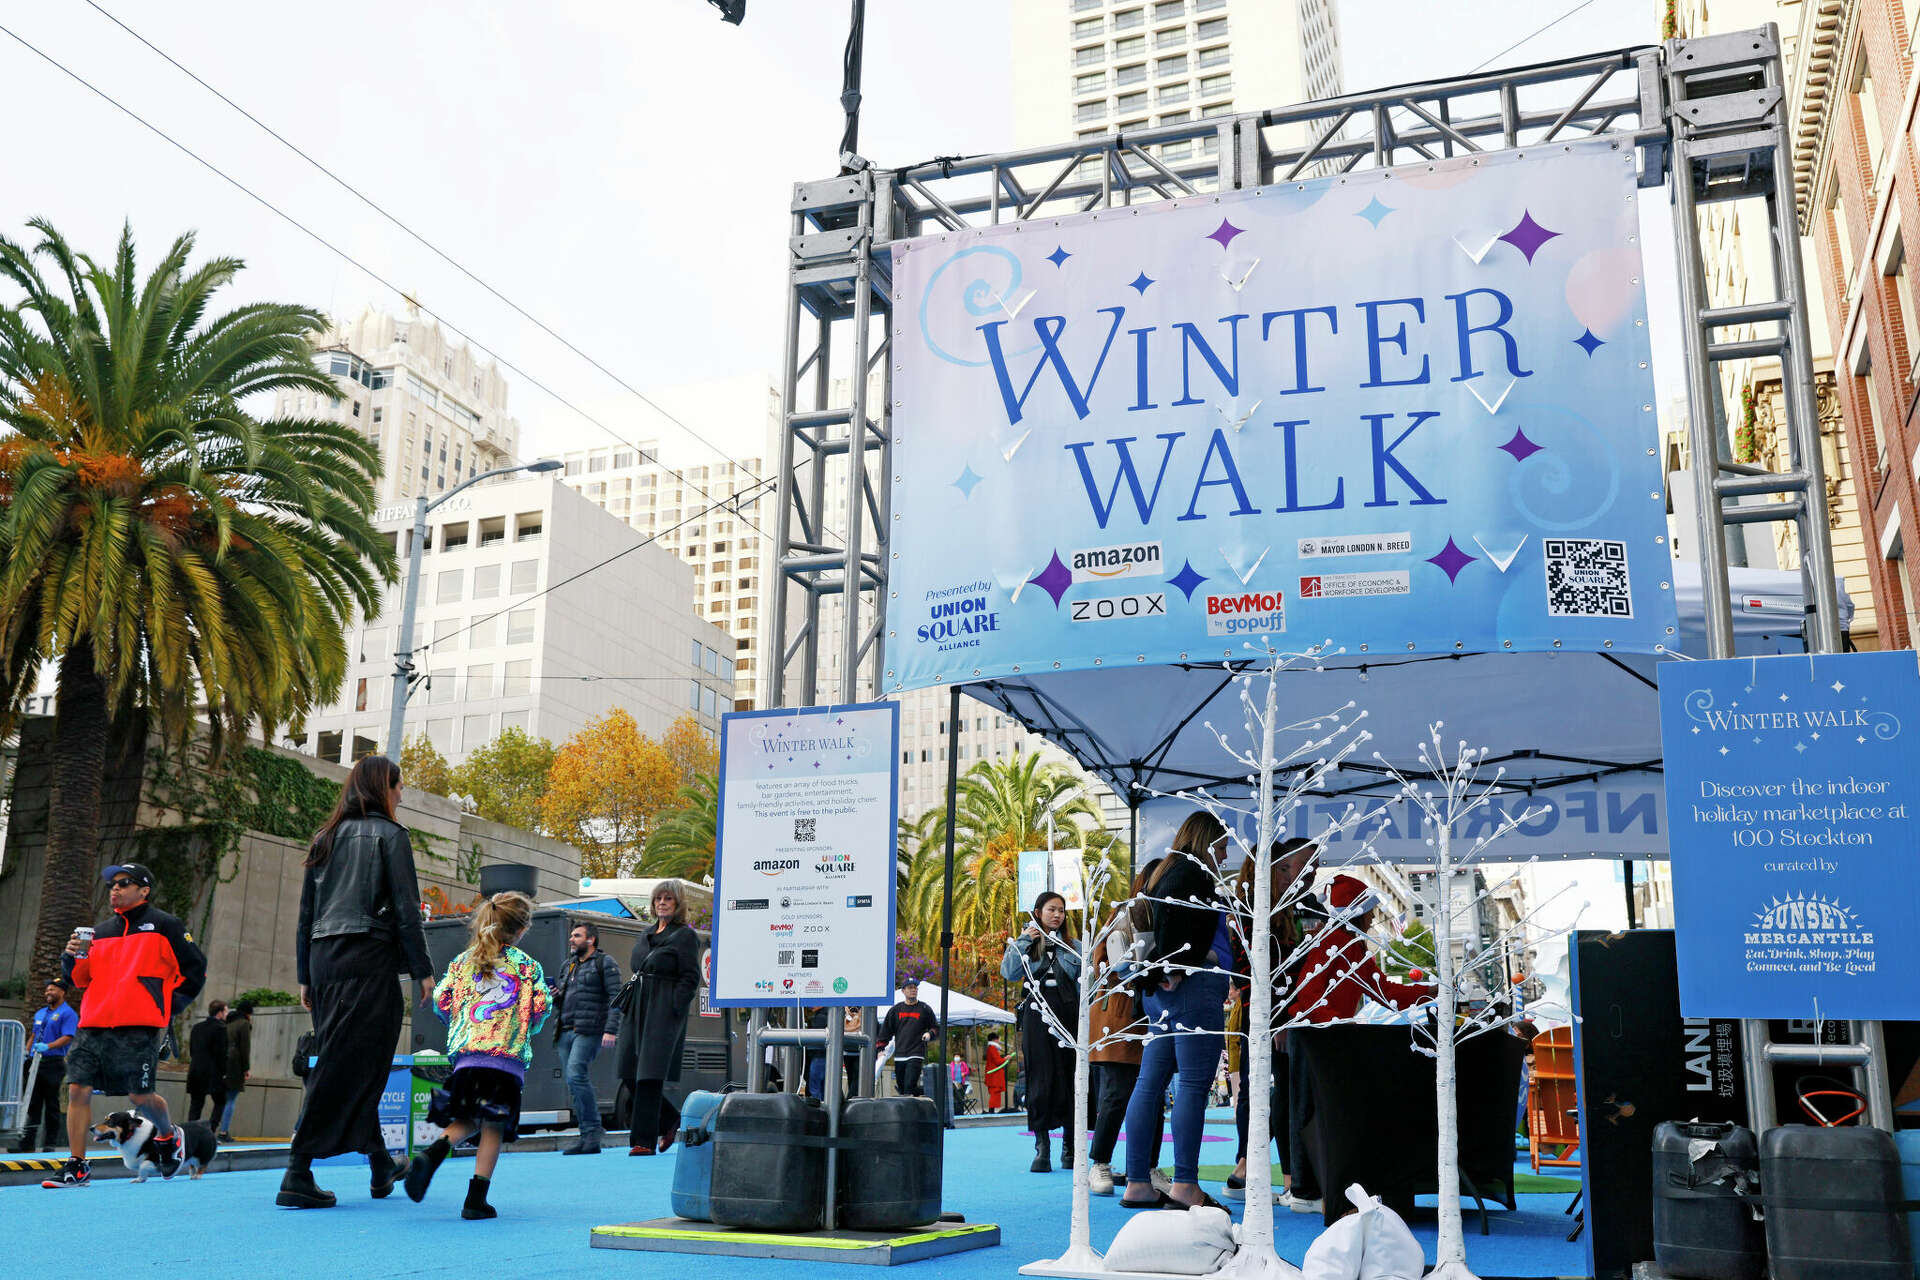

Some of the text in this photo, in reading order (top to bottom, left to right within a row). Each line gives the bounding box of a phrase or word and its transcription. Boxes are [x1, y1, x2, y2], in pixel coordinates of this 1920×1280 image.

[974, 286, 1535, 426] WINTER
[1064, 411, 1448, 530] WALK
[374, 504, 418, 522] TIFFAN
[1321, 545, 1345, 554] MAYOR
[1347, 543, 1375, 553] LONDON
[1386, 540, 1410, 550] BREED
[1073, 544, 1160, 569] amazon
[1323, 581, 1346, 589] OFFICE
[1358, 579, 1394, 588] ECONOMIC
[1568, 576, 1606, 584] SQUARE
[925, 581, 992, 601] Presented by
[1324, 586, 1408, 597] WORKFORCE DEVELOPMENT
[930, 597, 986, 619] UNION
[1072, 594, 1164, 620] ZOOX
[917, 612, 1001, 643] SQUARE
[1226, 612, 1284, 634] gopuff
[938, 639, 981, 652] ALLIANCE
[1705, 709, 1872, 731] WINTER WALK
[762, 736, 854, 753] WINTER WALK
[1700, 776, 1890, 798] Discover the indoor
[754, 810, 768, 818] This
[797, 808, 811, 816] free
[821, 807, 832, 815] the
[1692, 801, 1909, 825] holiday marketplace at
[1733, 828, 1873, 847] 100 Stockton
[753, 859, 800, 871] amazon
[822, 854, 850, 862] UNION
[1763, 857, 1839, 874] curated by
[814, 862, 856, 874] SQUARE
[1761, 900, 1848, 930] SUNSET
[1744, 932, 1874, 945] MERCANTILE
[1843, 947, 1875, 961] Play
[1799, 961, 1822, 973] and
[1823, 961, 1842, 973] Be
[1844, 961, 1876, 976] Local
[381, 1091, 406, 1103] CYCLE
